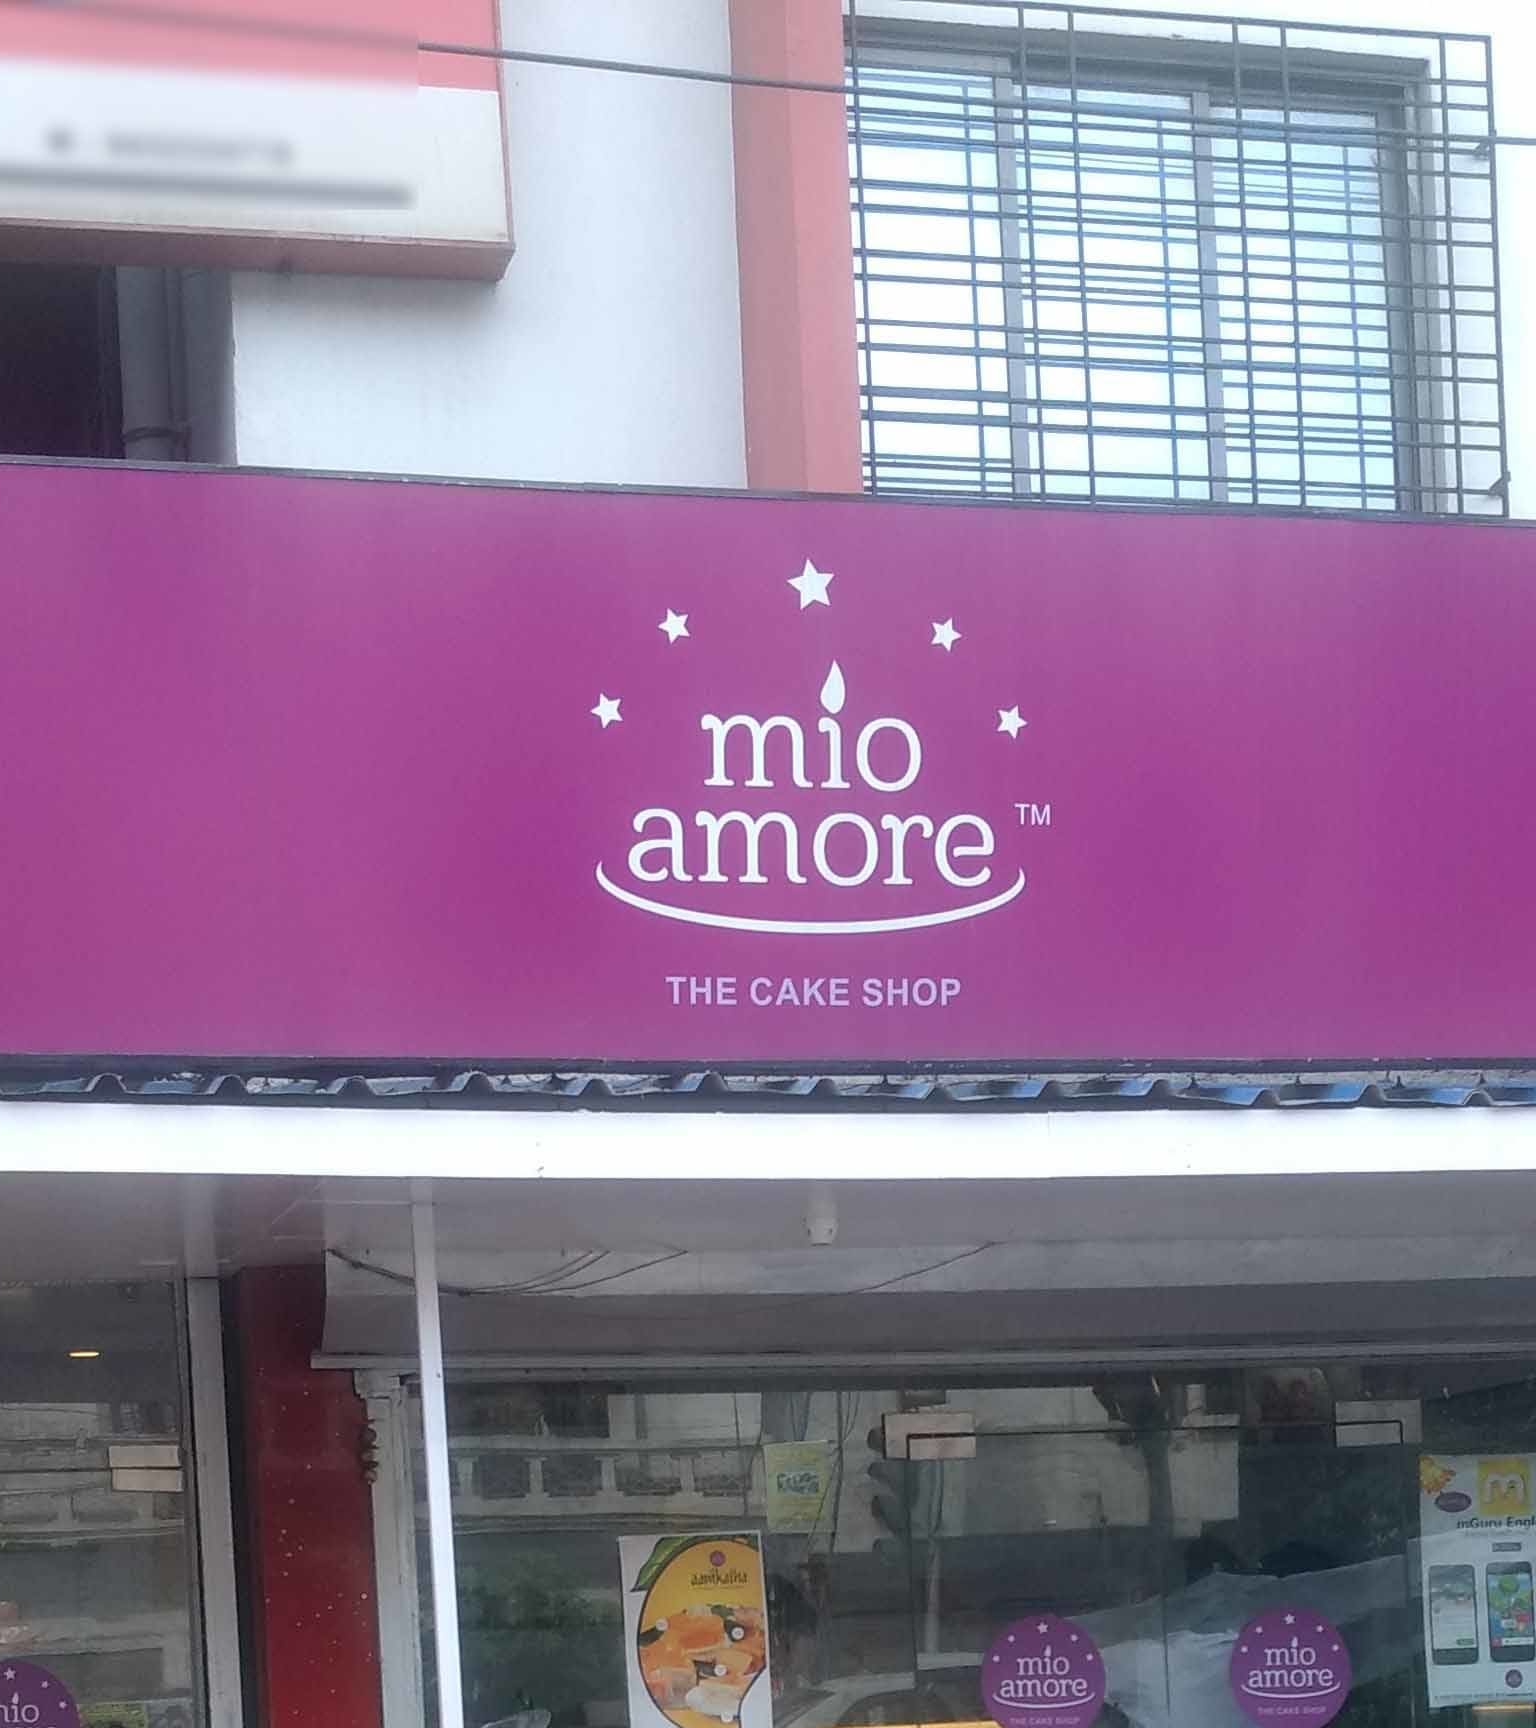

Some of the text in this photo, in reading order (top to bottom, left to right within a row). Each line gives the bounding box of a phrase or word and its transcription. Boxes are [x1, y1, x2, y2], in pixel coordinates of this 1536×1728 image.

[700, 660, 923, 792] mio
[627, 807, 995, 887] amore
[666, 976, 962, 1007] THE CAKE SHOP
[1016, 1645, 1070, 1676] mio
[1263, 1636, 1316, 1666] mio
[999, 1678, 1088, 1698] amore
[1248, 1668, 1334, 1688] amore
